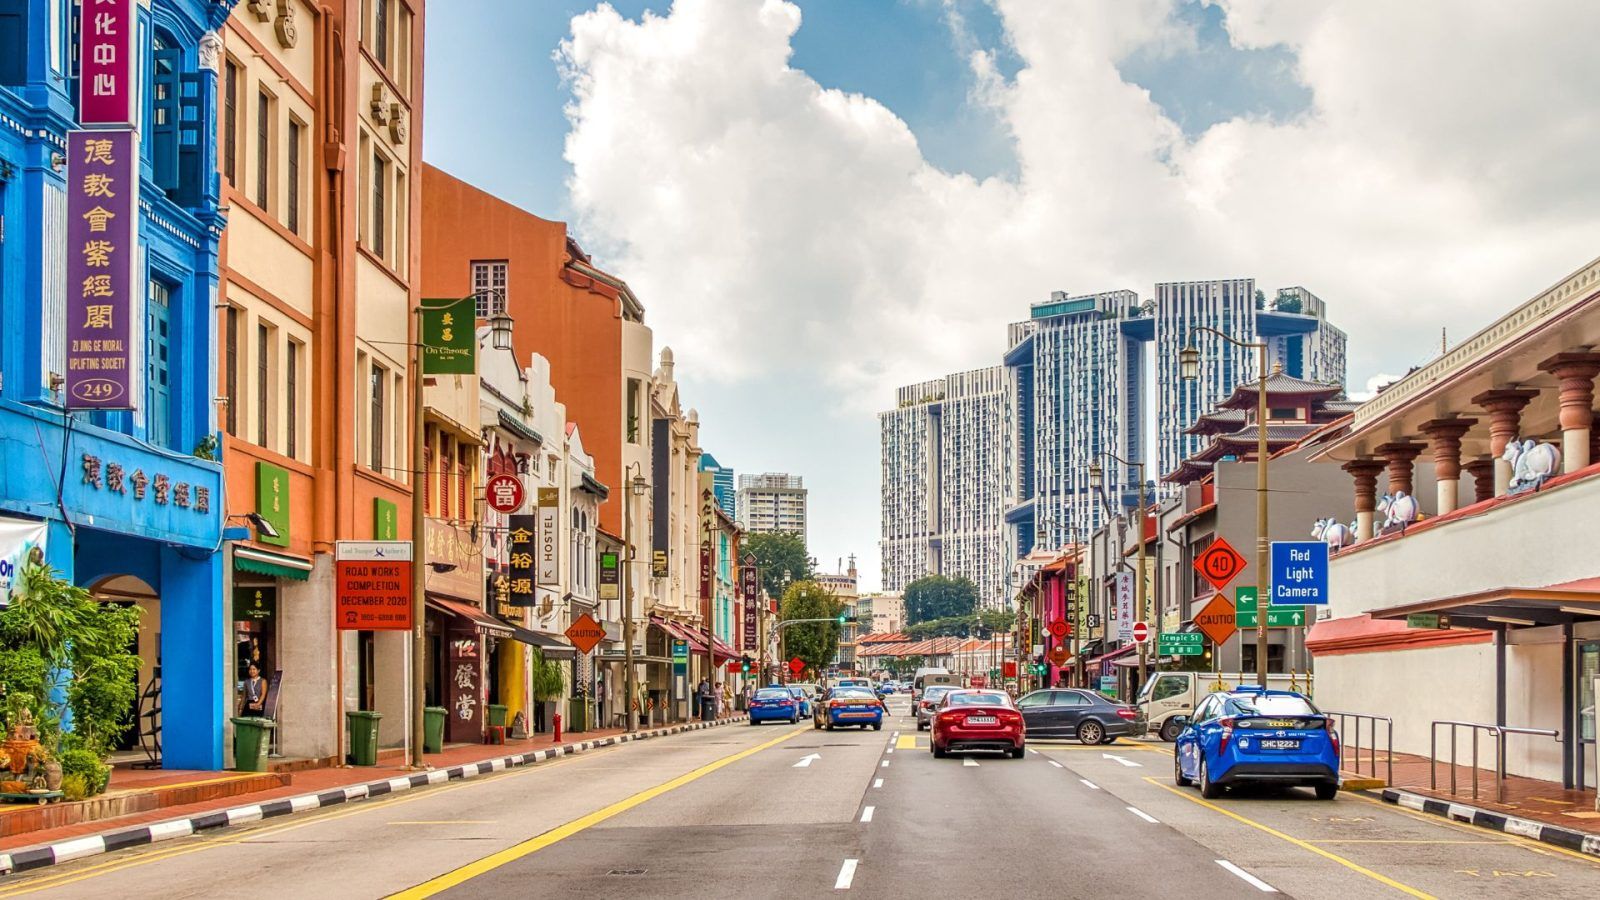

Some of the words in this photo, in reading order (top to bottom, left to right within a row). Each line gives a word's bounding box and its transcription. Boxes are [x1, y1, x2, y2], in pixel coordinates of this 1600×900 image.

[93, 0, 117, 96] 化中心
[93, 340, 102, 352] GE
[102, 340, 123, 352] MORAL
[69, 357, 100, 370] UPLIFTING
[101, 357, 126, 370] SOCIETY
[82, 383, 113, 397] 249
[493, 479, 517, 507] 當
[544, 515, 553, 562] HOSTEL
[510, 527, 533, 594] 金裕源
[1290, 548, 1310, 562] Red
[1212, 556, 1228, 571] 40
[345, 566, 368, 577] ROAD
[371, 566, 400, 577] WORKS
[1286, 566, 1314, 581] Light
[347, 581, 400, 591] COMPLETION
[1277, 584, 1319, 598] Camera
[341, 596, 384, 606] DECEMBER
[386, 596, 407, 606] 2020
[1200, 614, 1235, 625] CAUTIO
[570, 629, 601, 638] CAUTION
[1162, 634, 1188, 642] Temple
